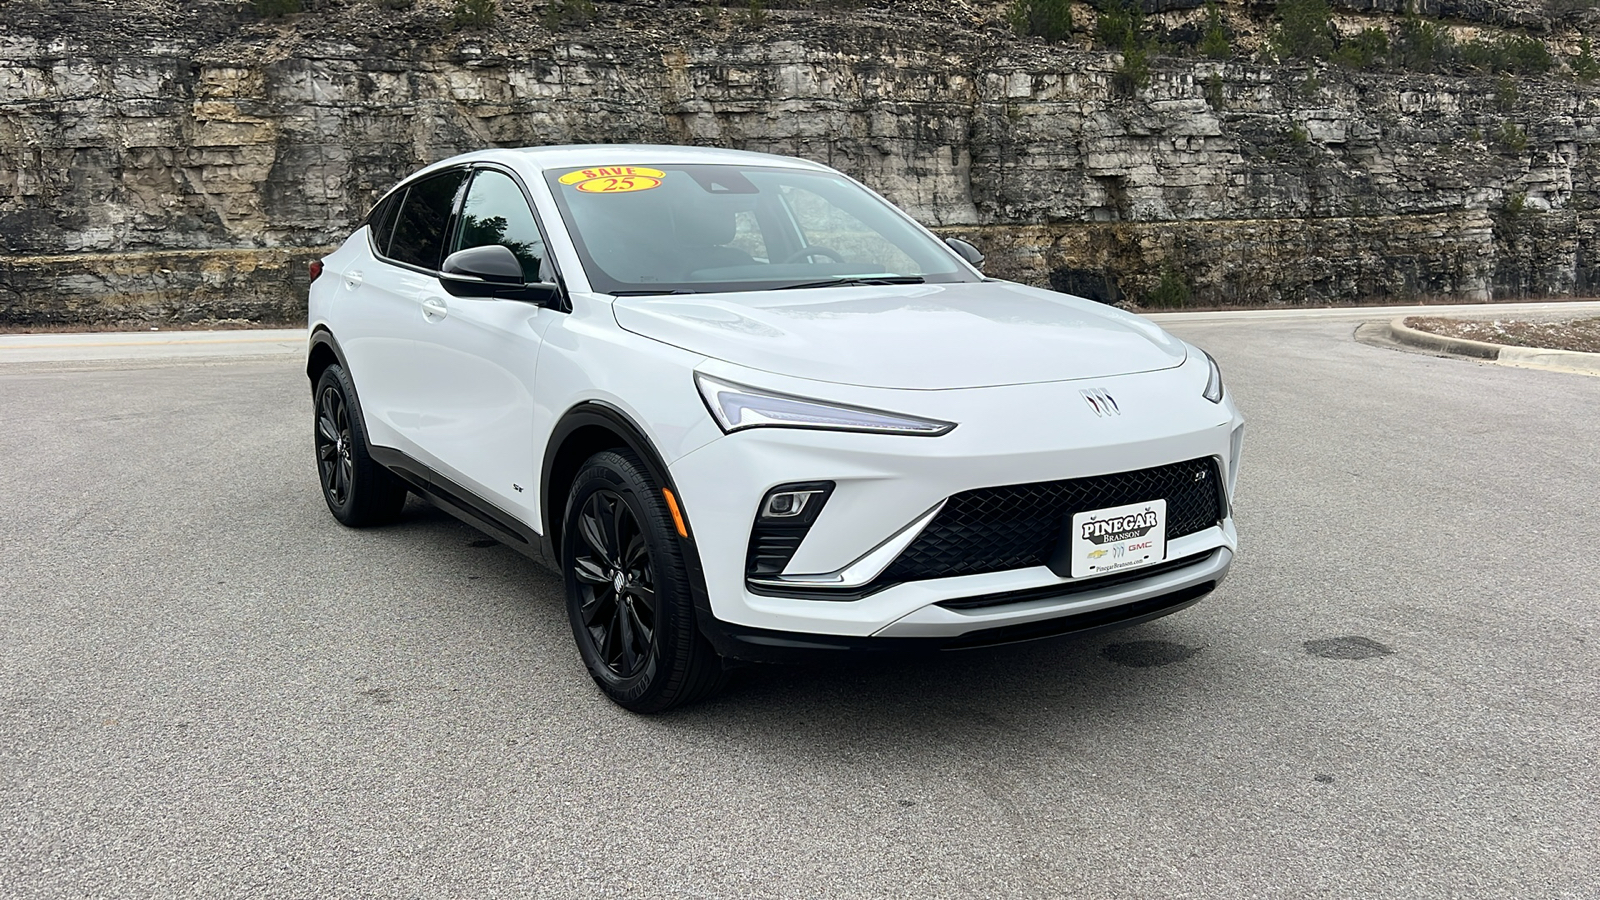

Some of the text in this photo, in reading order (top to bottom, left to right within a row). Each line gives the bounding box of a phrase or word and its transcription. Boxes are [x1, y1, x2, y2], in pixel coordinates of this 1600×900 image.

[582, 167, 636, 178] SAVE
[603, 177, 635, 191] 25
[1082, 512, 1157, 538] PINEGAR
[1103, 531, 1140, 543] BRANSON
[1128, 541, 1152, 551] GMC
[1096, 558, 1143, 572] PinegarBranson.com
